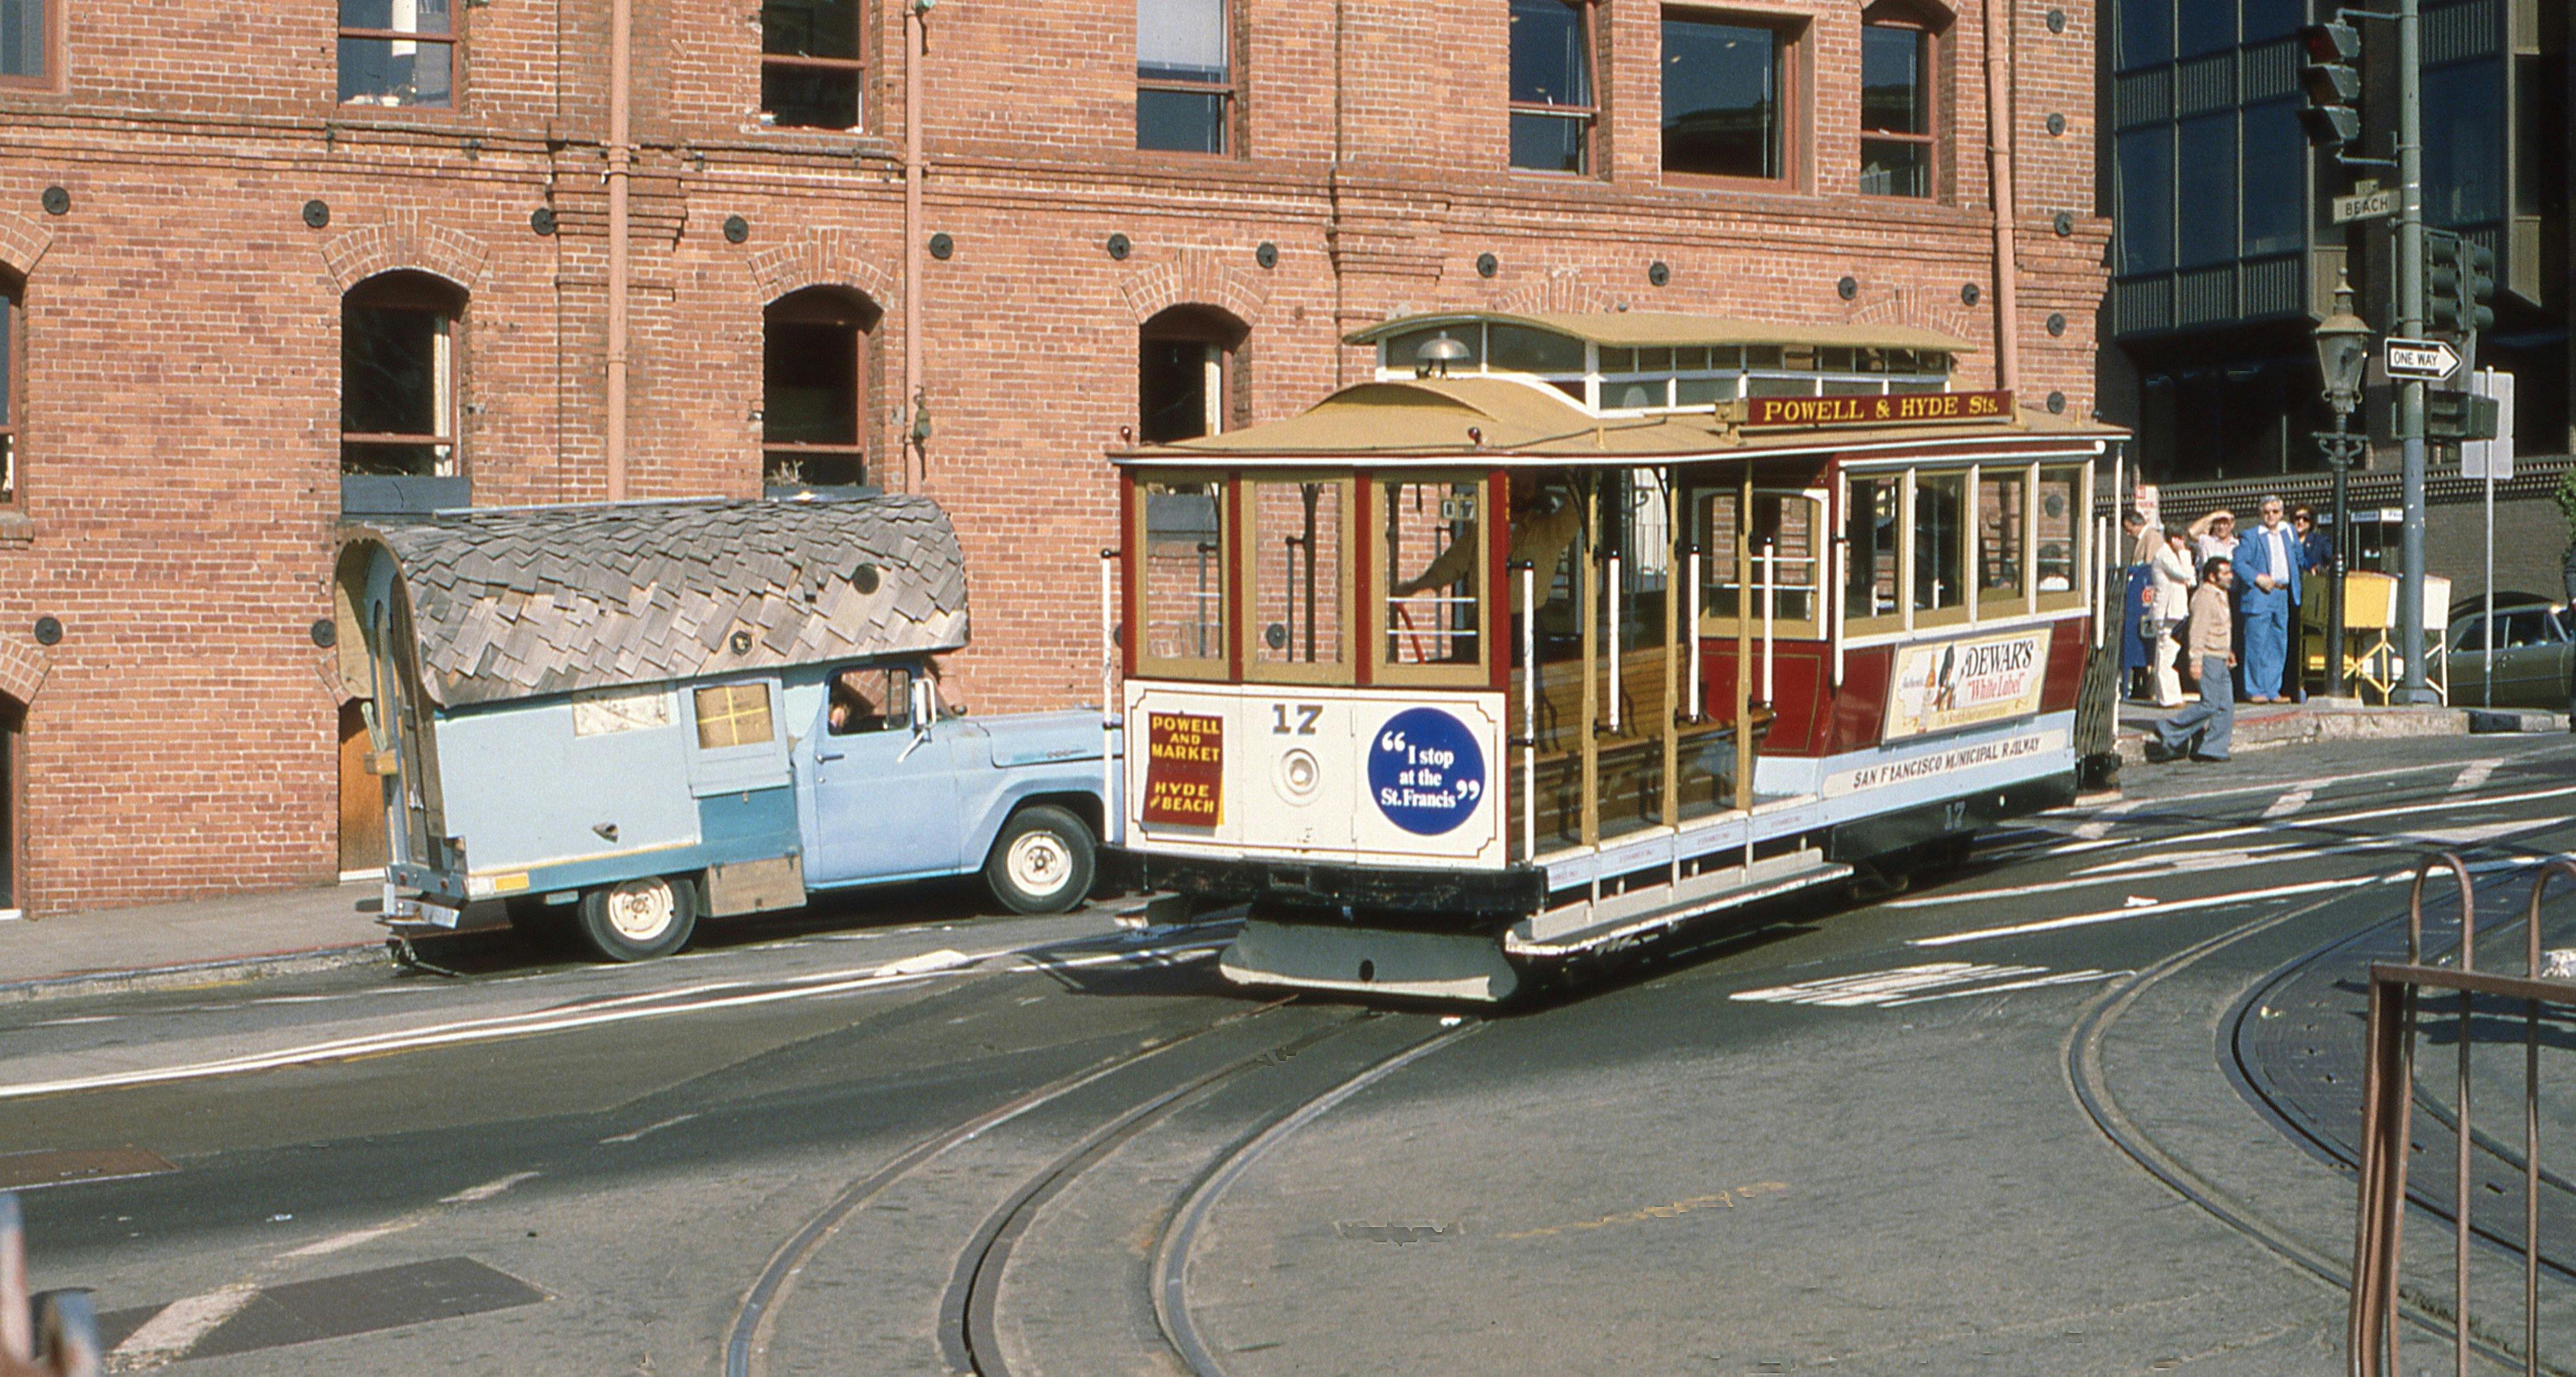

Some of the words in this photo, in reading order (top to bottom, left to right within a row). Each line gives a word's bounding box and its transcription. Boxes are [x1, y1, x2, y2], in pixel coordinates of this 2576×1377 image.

[2346, 198, 2388, 215] BEACH
[2394, 351, 2414, 365] ONE
[2418, 353, 2438, 366] WAY
[1764, 400, 1864, 421] POWELL
[1875, 399, 1890, 418] &
[1901, 396, 1958, 417] HYDE
[1969, 395, 1998, 414] Sts.
[1962, 640, 2033, 678] DEWAR'S
[1153, 716, 1220, 734] POWELL
[1273, 704, 1323, 735] 17
[1170, 733, 1201, 745] AND
[1151, 744, 1219, 762] MARKET
[1419, 747, 1454, 769] stop
[1854, 769, 1877, 788] SAN
[1945, 744, 1997, 769] MUNICIPAL
[1399, 770, 1415, 785] at
[1418, 768, 1442, 786] the
[1155, 781, 1209, 797] HYDE
[1162, 796, 1214, 813] BEACH
[1945, 801, 1966, 830] 17
